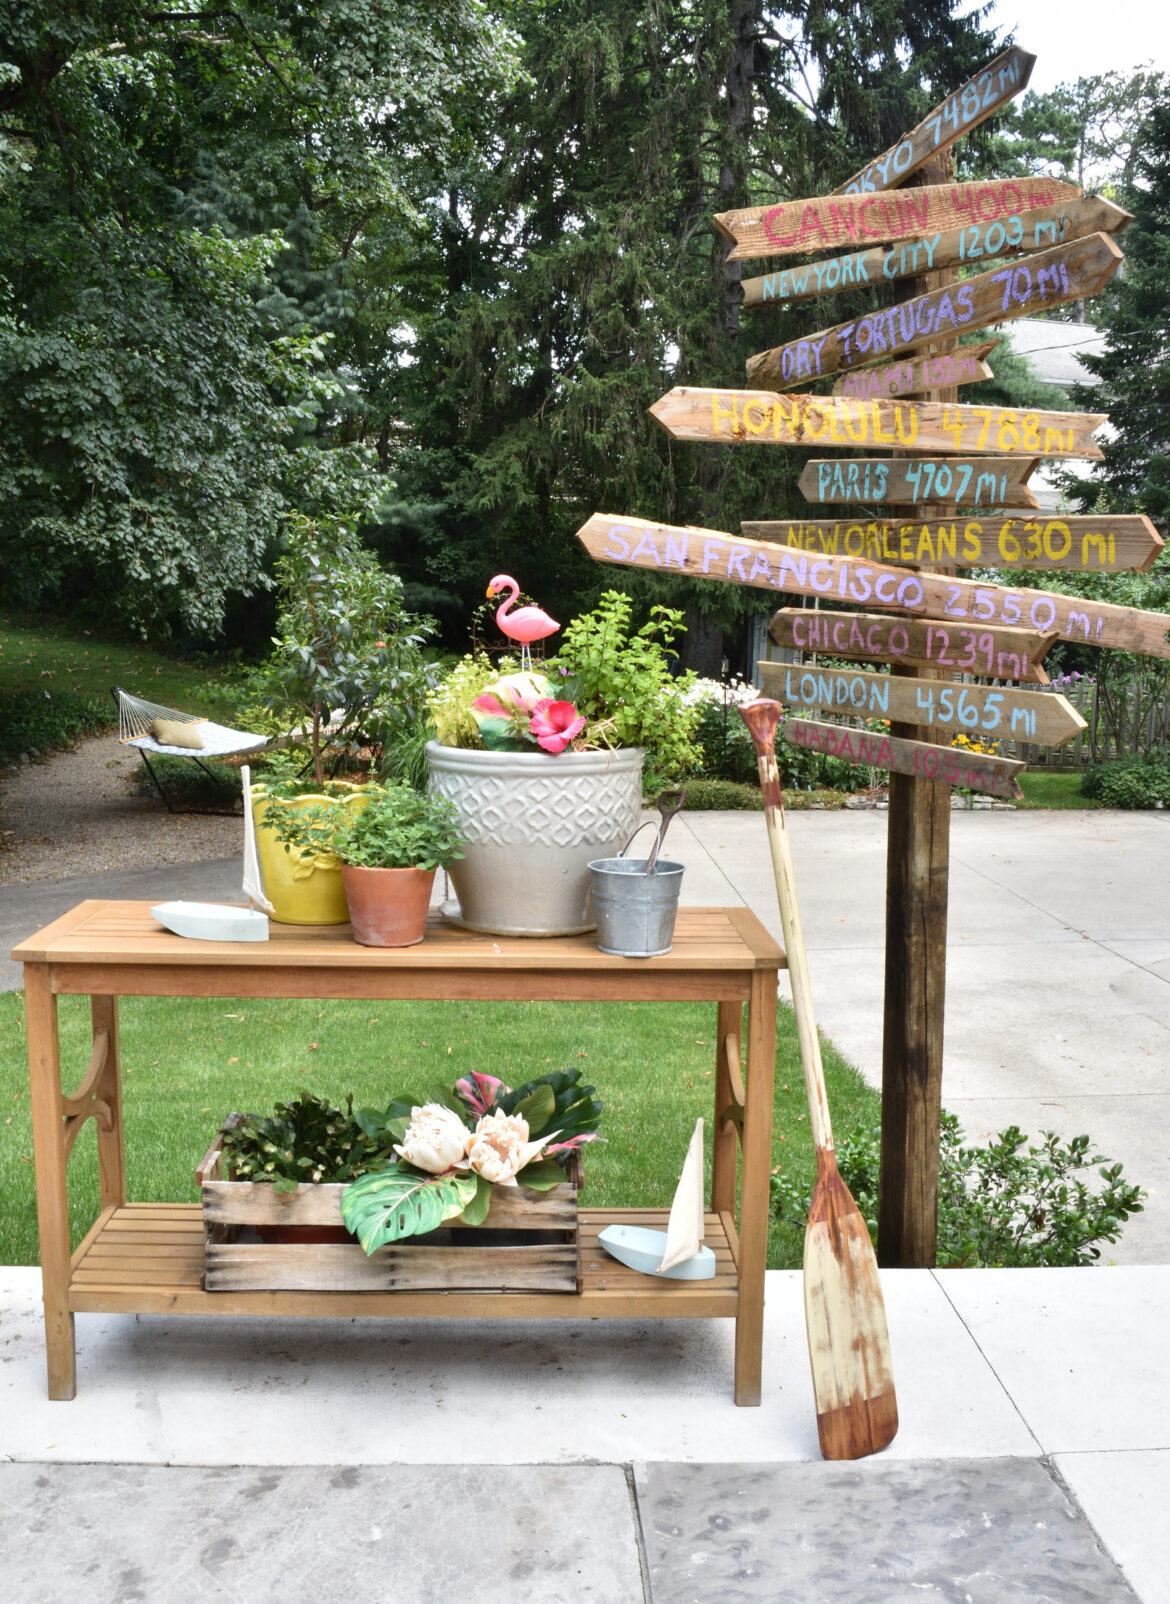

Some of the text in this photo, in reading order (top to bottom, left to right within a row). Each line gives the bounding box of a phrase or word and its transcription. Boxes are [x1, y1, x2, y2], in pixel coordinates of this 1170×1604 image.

[845, 141, 912, 195] KYO
[926, 72, 999, 145] 7482
[950, 184, 1023, 224] 400
[763, 270, 809, 301] NEW
[814, 252, 869, 291] YORK
[883, 234, 941, 279] CITY
[959, 217, 1023, 260] 1203
[781, 264, 1069, 381] DRY TORTUGAS 70 MI
[843, 363, 914, 400] MIAMI
[923, 356, 957, 386] 132
[712, 396, 918, 446] HONOLULU
[943, 408, 1043, 451] 4788
[818, 462, 889, 502] PARIS
[906, 463, 973, 504] 4707
[787, 524, 840, 556] NEW
[844, 522, 983, 561] ORLEANS
[997, 520, 1072, 562] 630
[604, 525, 689, 568] SAN
[702, 539, 924, 607] FRANCISCO
[944, 585, 1057, 630] 2550
[926, 626, 995, 674] 1239
[785, 669, 890, 714] LONDON
[916, 686, 1005, 731] 4565
[794, 722, 895, 771] HABANA
[914, 746, 960, 784] 105
